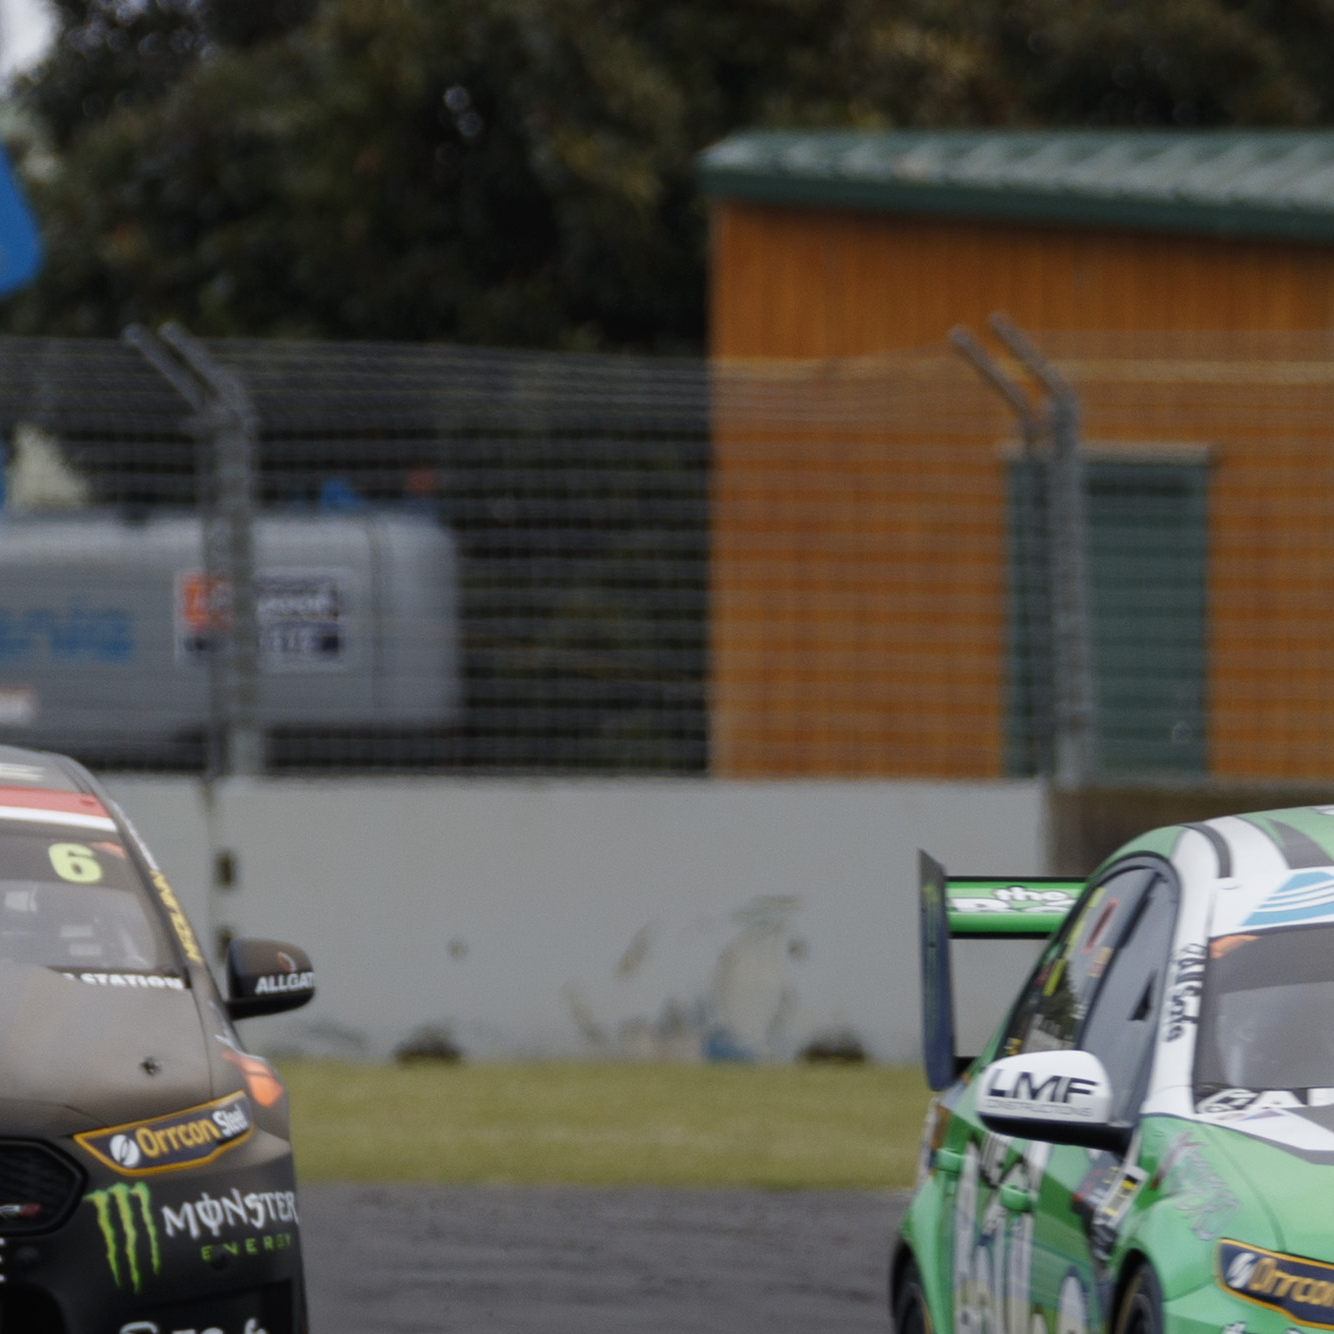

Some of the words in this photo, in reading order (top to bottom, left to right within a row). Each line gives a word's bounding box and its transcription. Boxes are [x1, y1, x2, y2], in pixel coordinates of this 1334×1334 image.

[48, 842, 103, 884] 6
[255, 970, 316, 994] ALLGAT
[988, 1069, 1100, 1103] LMF
[135, 1118, 220, 1158] Orrcon
